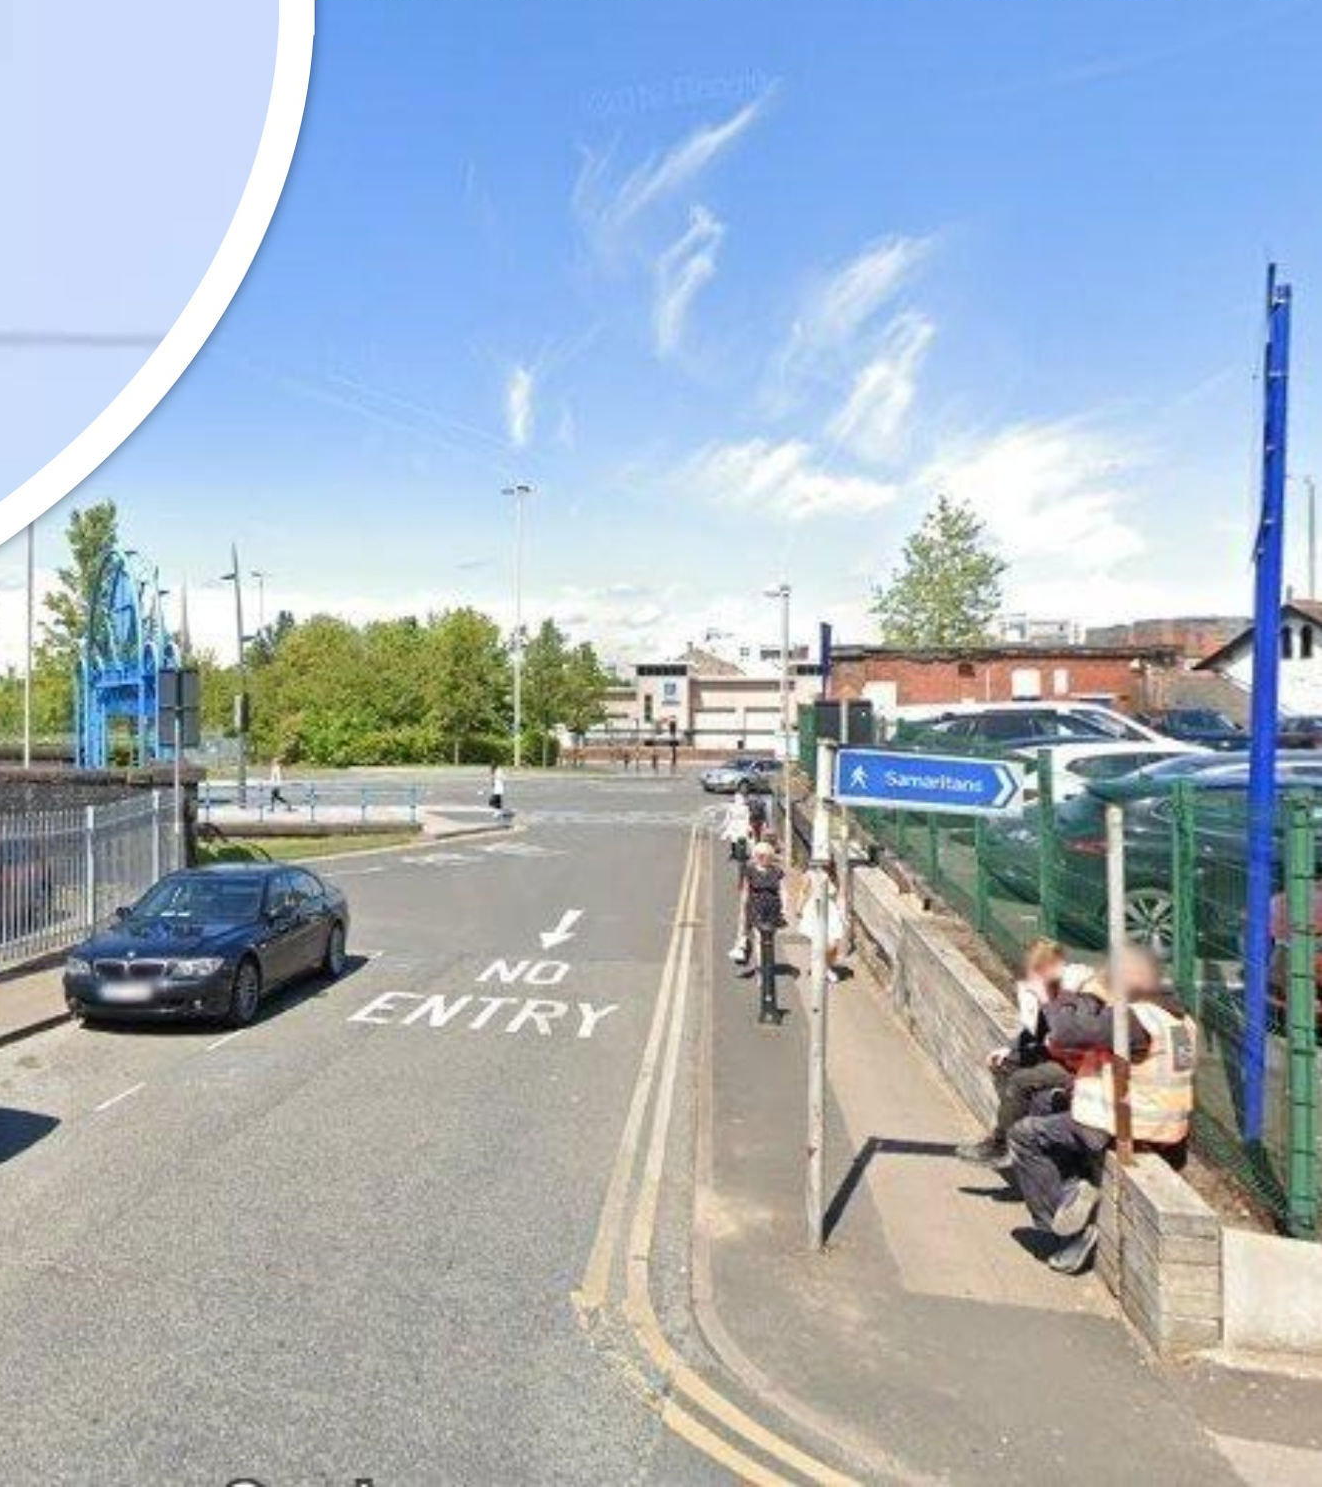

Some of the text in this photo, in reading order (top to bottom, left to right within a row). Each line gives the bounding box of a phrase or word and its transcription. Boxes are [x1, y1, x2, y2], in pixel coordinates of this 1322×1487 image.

[884, 768, 984, 793] Samaritans
[475, 959, 572, 985] NO
[346, 990, 621, 1040] ENTRY
